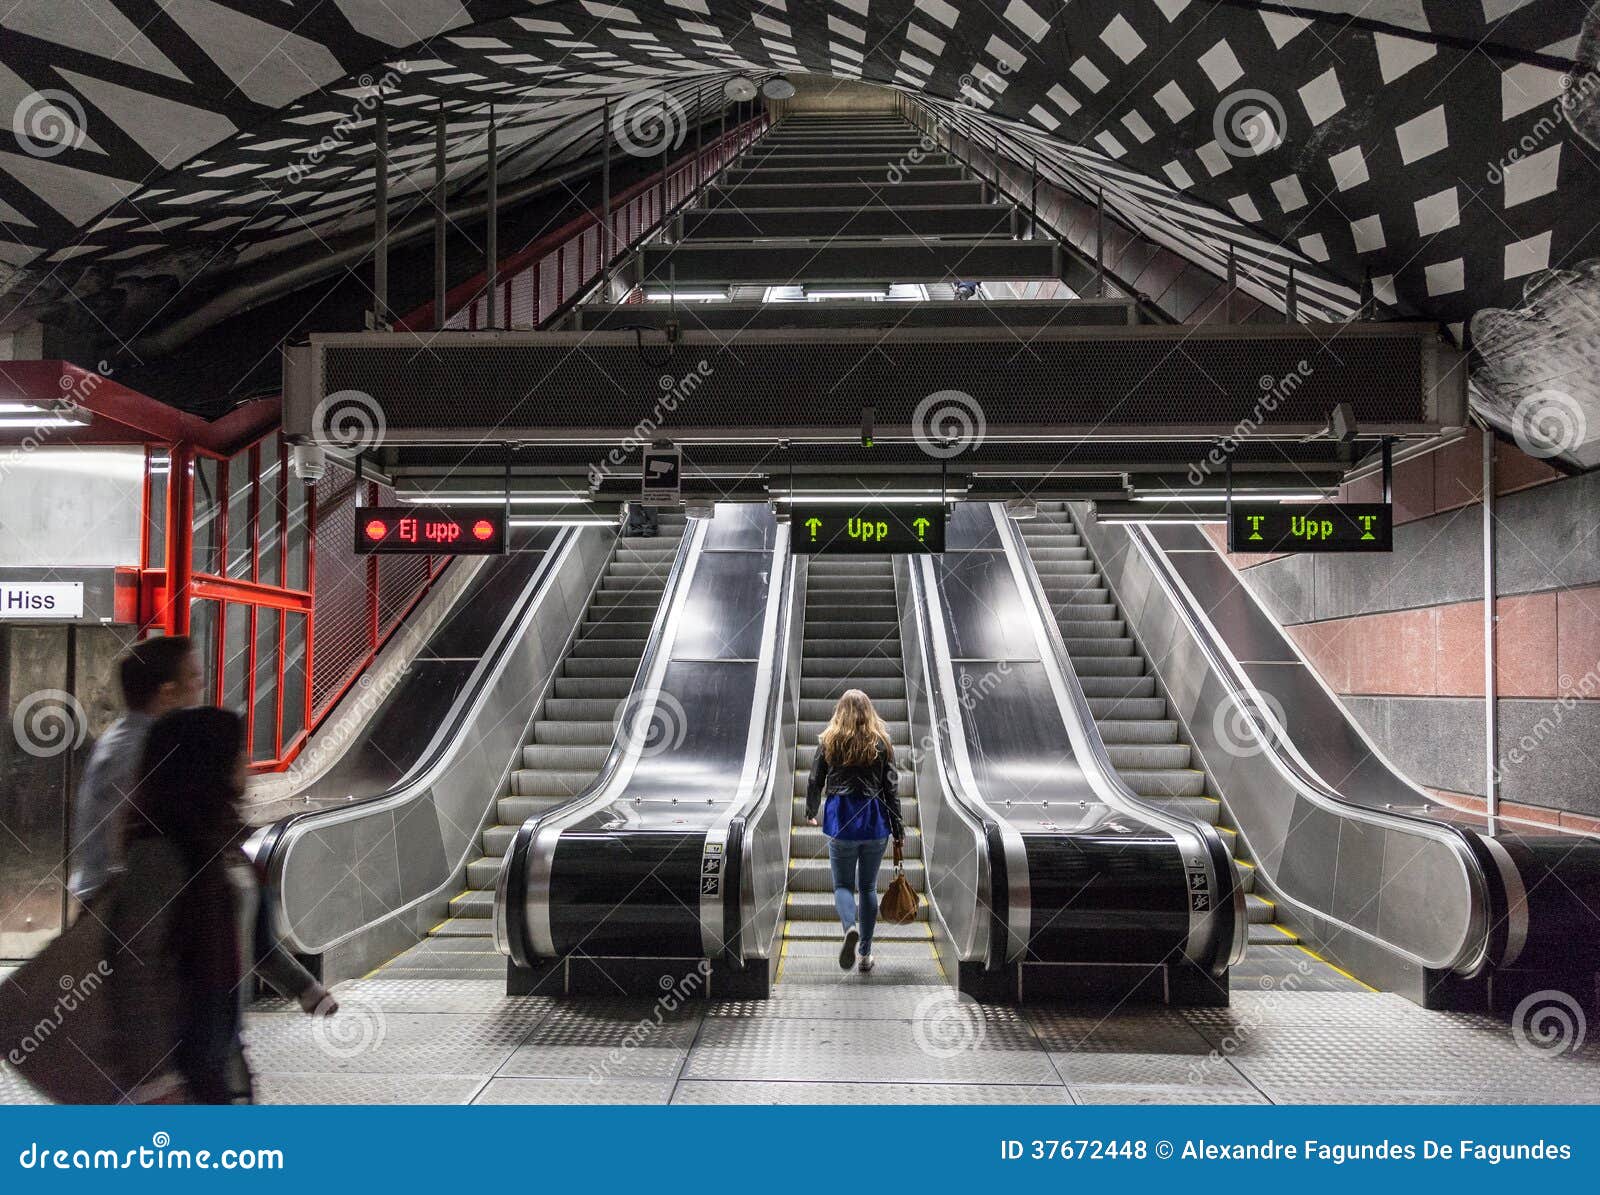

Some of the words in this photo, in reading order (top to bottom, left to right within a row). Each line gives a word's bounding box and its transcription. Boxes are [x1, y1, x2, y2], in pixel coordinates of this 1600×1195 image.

[399, 519, 417, 542] Ej
[425, 522, 460, 542] upp
[848, 518, 888, 541] Upp
[1291, 516, 1333, 540] Upp
[8, 591, 55, 609] Hiss
